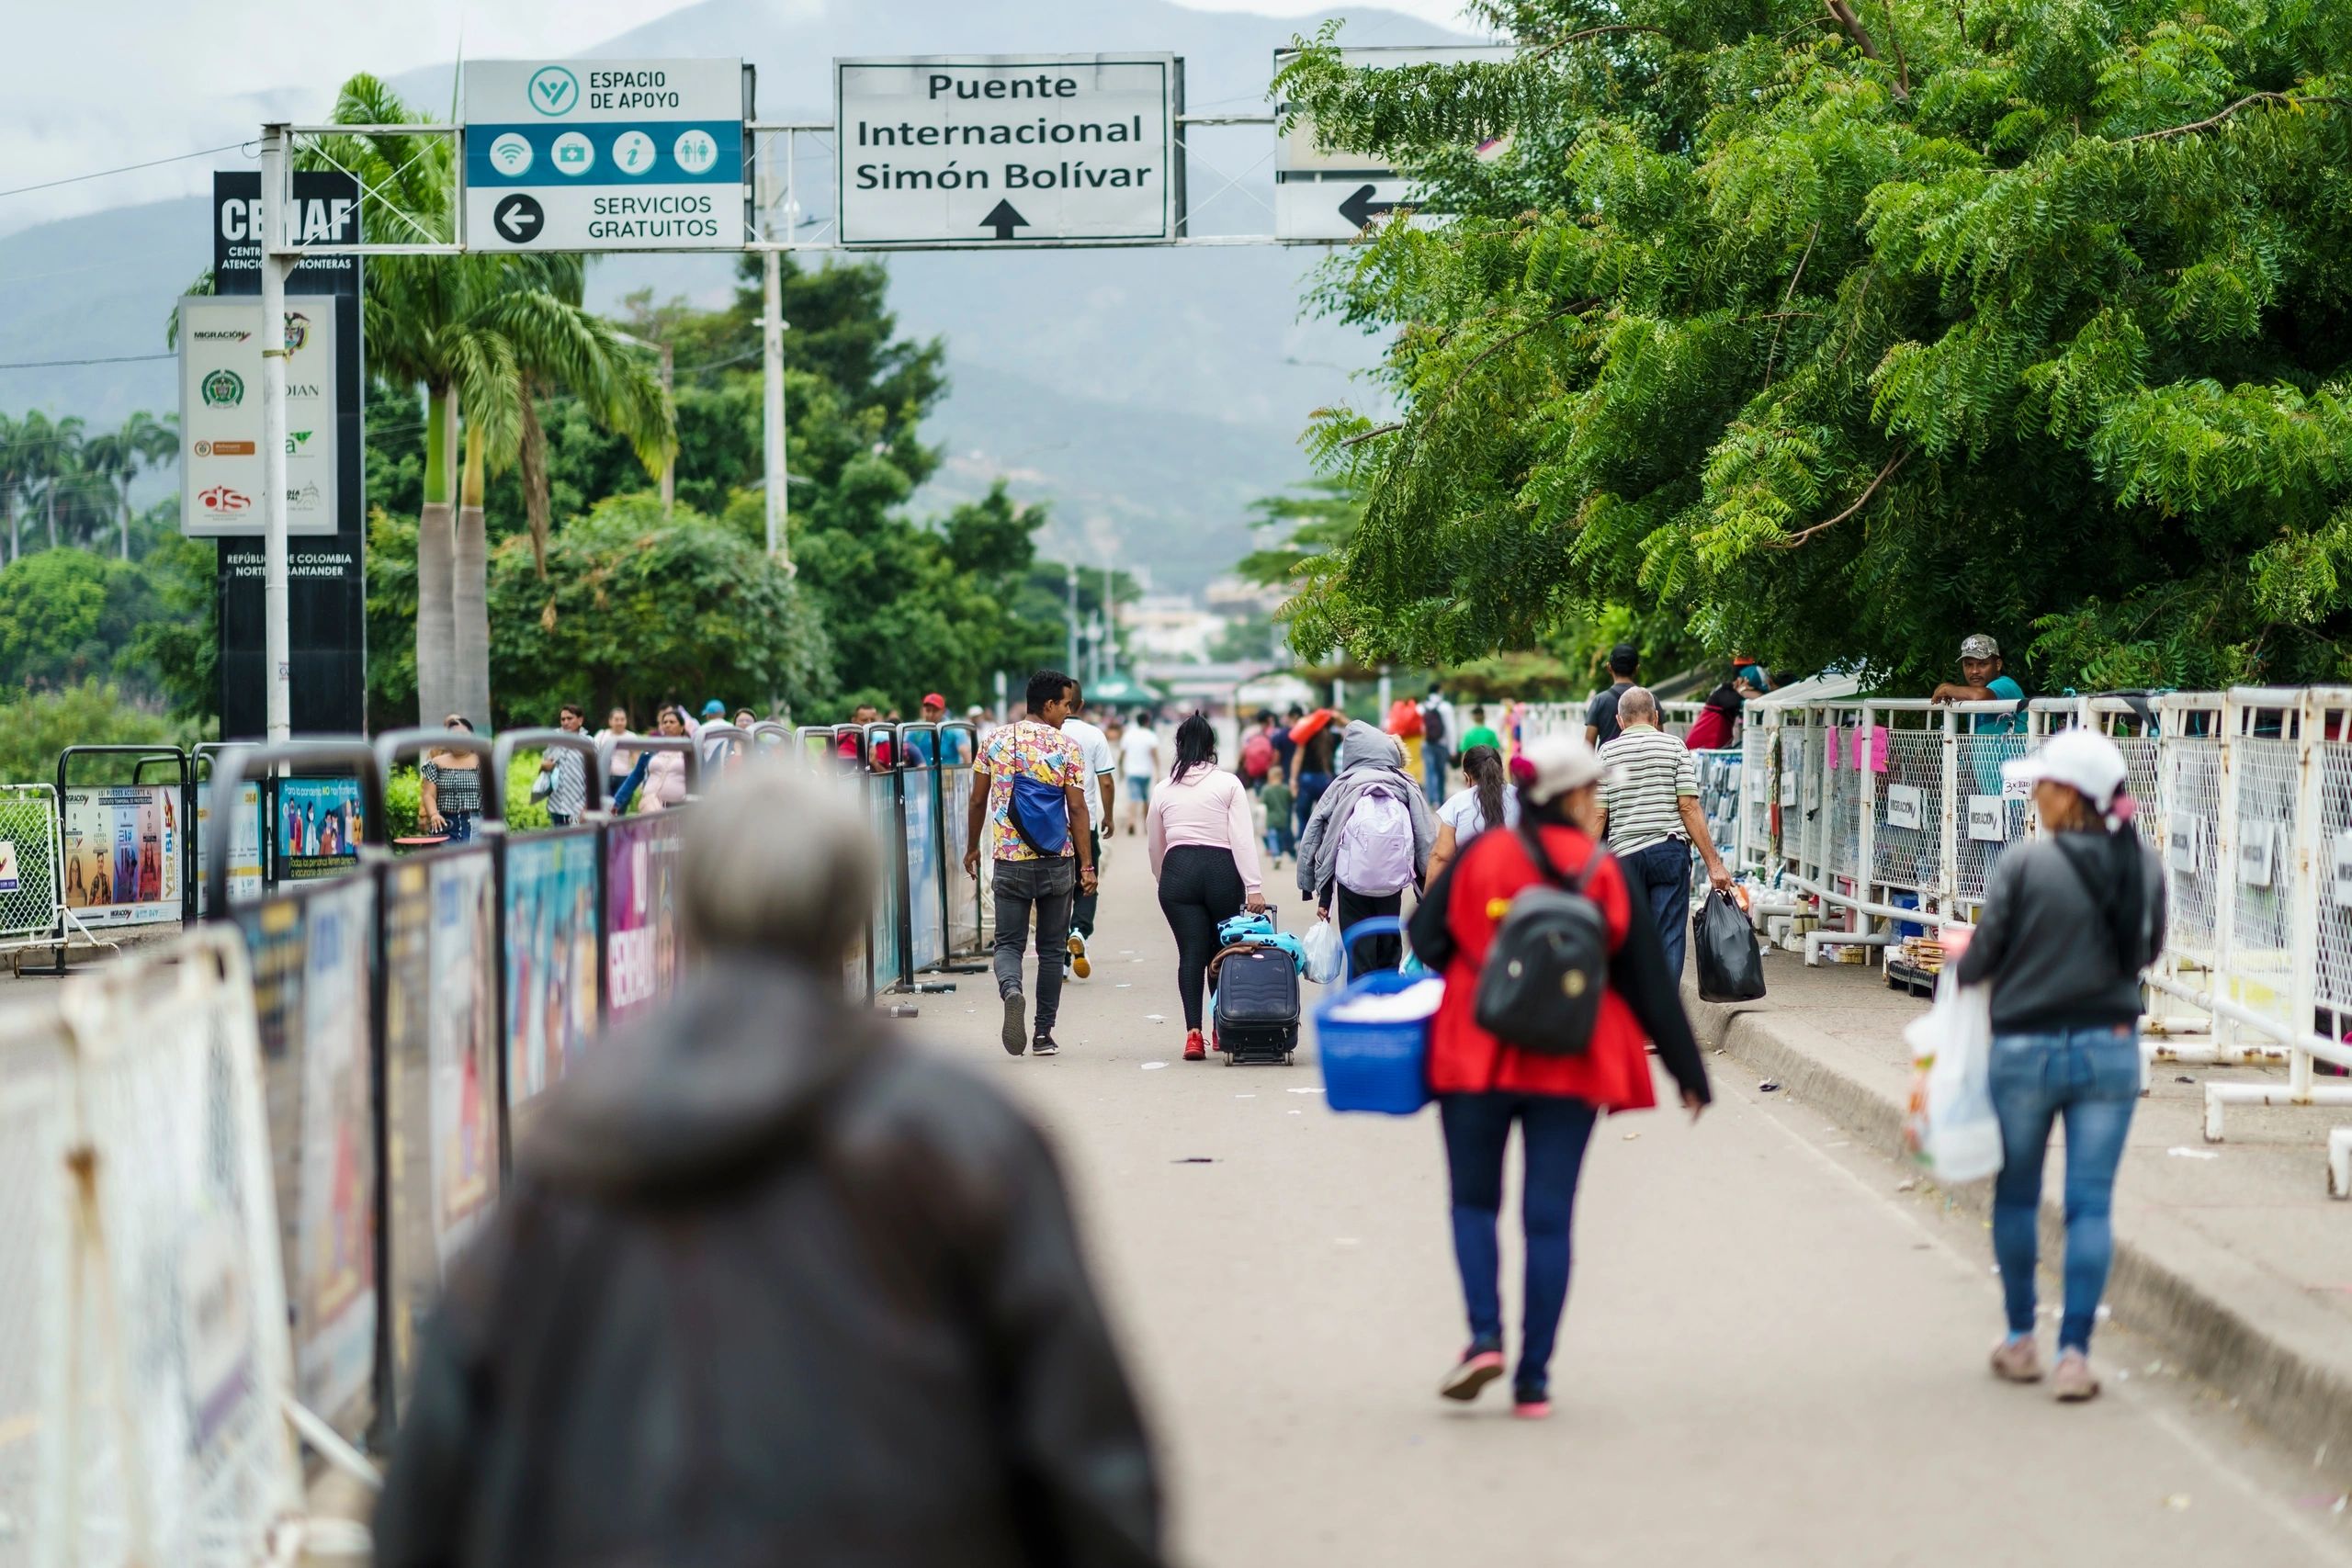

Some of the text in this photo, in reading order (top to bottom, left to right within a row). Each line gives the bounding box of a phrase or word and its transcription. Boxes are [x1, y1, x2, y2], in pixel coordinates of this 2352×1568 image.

[591, 71, 665, 88] ESPACIO
[929, 74, 1078, 100] Puente
[591, 92, 680, 108] DE APOYO
[858, 115, 1142, 146] Internacional
[856, 160, 1152, 190] Simón Bolívar
[594, 196, 712, 215] SERVICIOS
[588, 219, 718, 239] GRATUITOS
[229, 246, 263, 257] CENTR
[221, 259, 263, 270] ATENCI
[194, 329, 245, 339] MIGRACIÓN
[227, 552, 266, 564] REPÚBLI
[297, 553, 352, 564] COLOMBIA
[322, 785, 330, 796] NO
[1890, 799, 1913, 815] MIGRACIÓN
[1971, 810, 1995, 825] MIGRACIÓN
